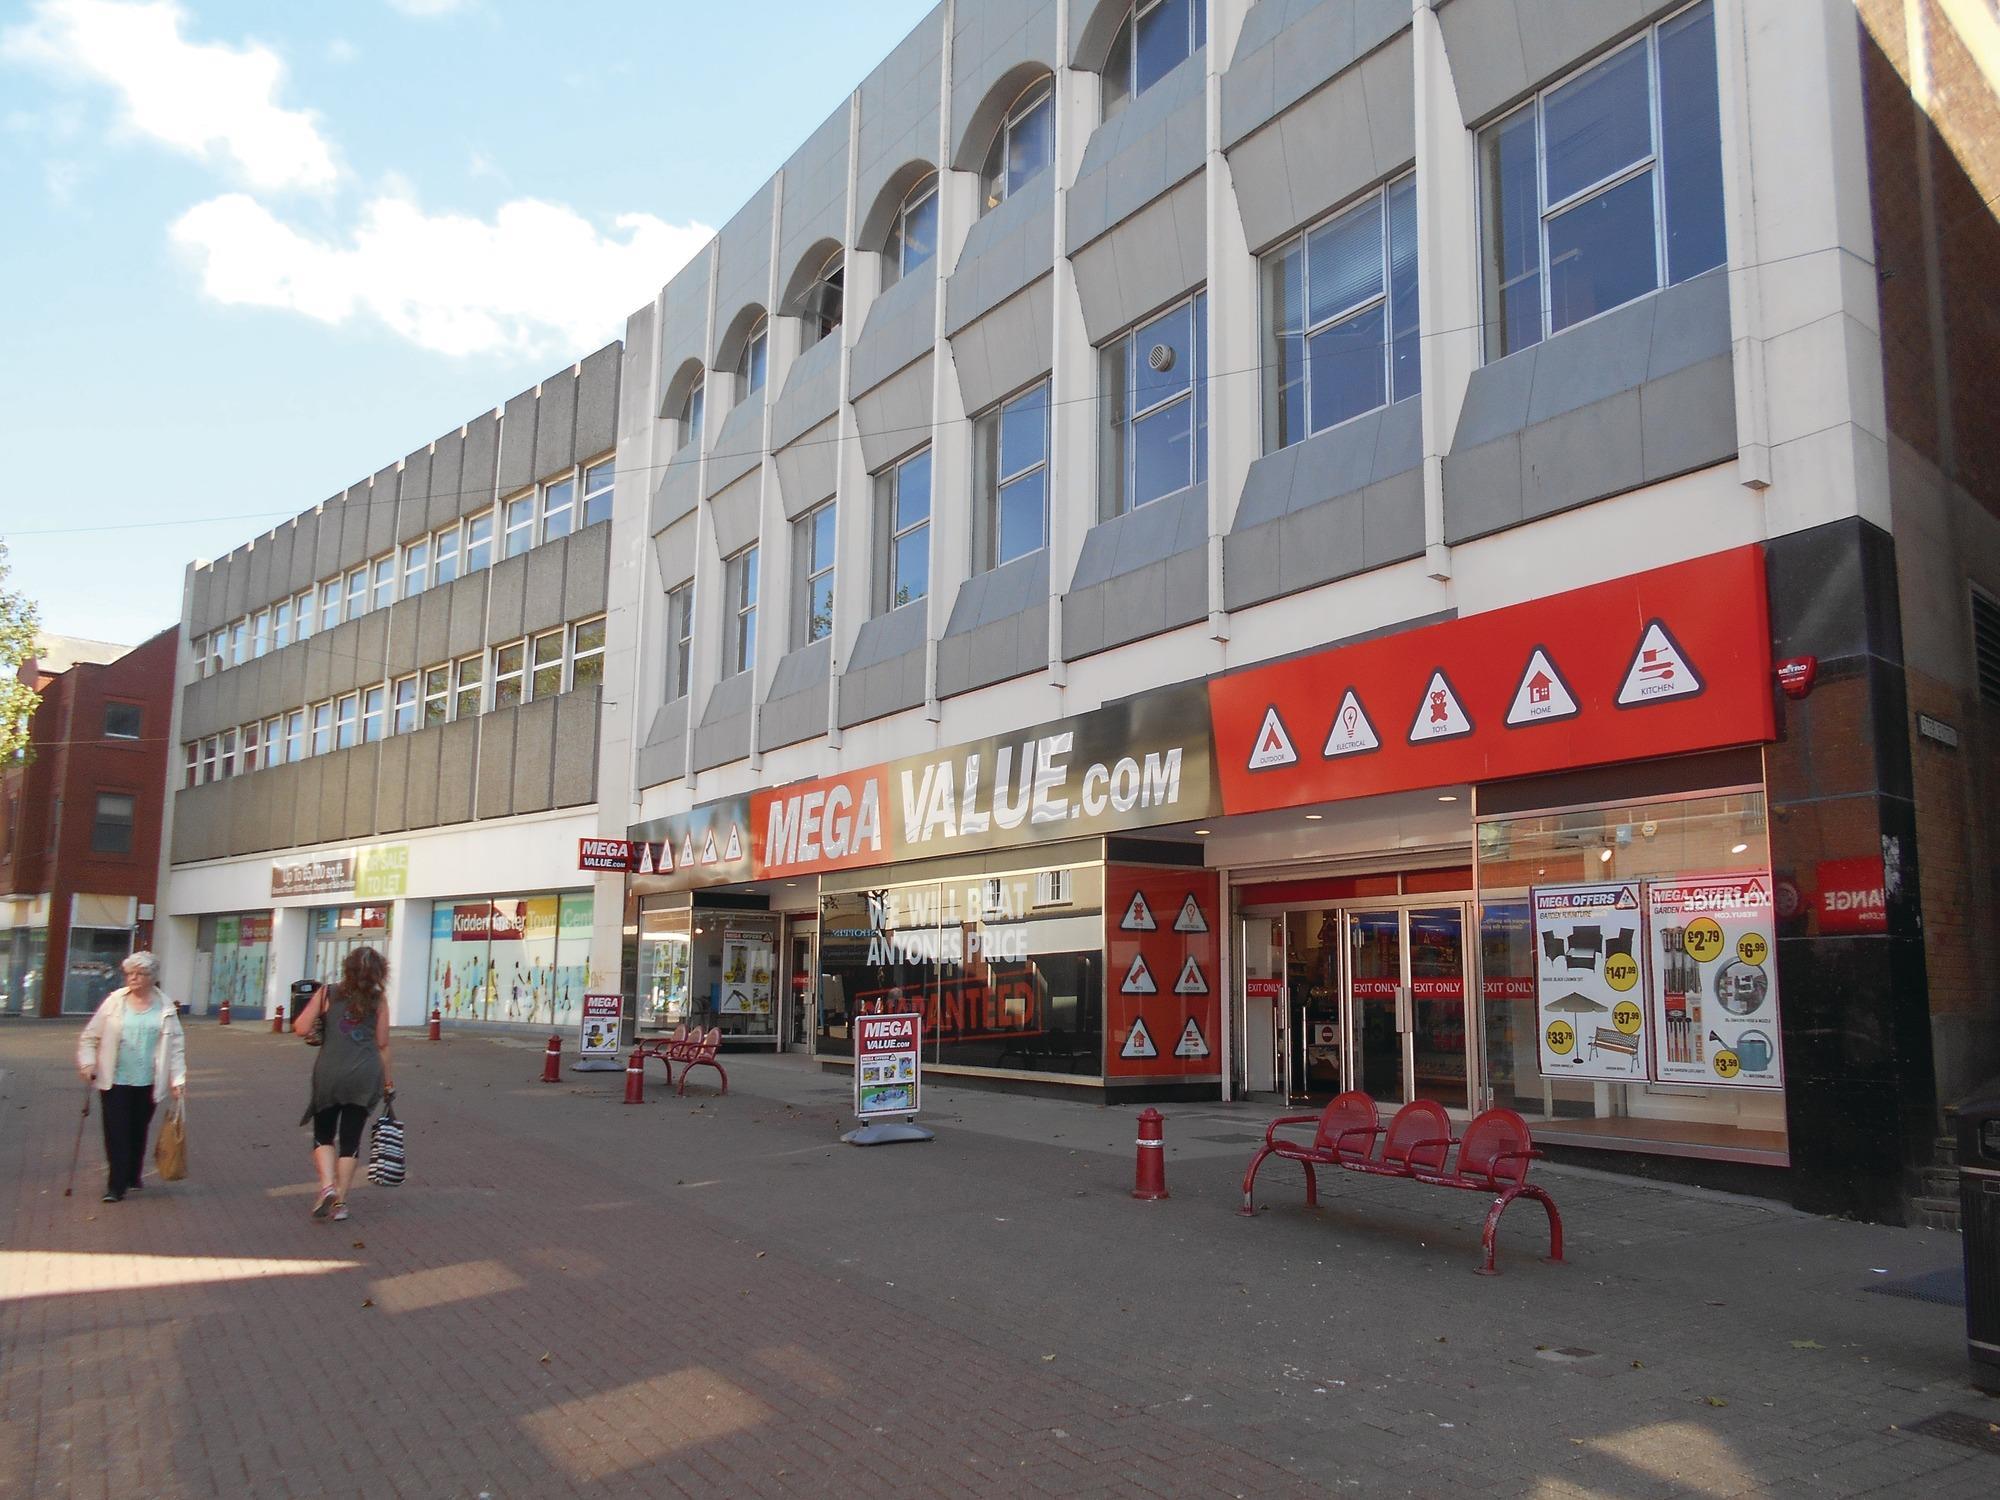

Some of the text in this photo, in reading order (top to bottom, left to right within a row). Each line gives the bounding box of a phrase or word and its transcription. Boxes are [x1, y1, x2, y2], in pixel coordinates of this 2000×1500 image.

[1640, 683, 1675, 696] KITCHEN
[1531, 706, 1552, 716] HOME
[1432, 725, 1448, 734] TOYS
[1336, 740, 1365, 750] ELECTRICAL
[1260, 754, 1285, 764] OUTDOOR
[764, 731, 1183, 867] MEGA VALUE.COM
[582, 841, 629, 857] MEGA
[1540, 893, 1615, 908] MEGA OFFERS
[1655, 888, 1689, 902] MEGA
[908, 888, 960, 928] WILL
[867, 927, 1028, 967] ANYONES PRICE
[1687, 930, 1720, 951] £2.79
[1739, 942, 1765, 958] £6.99
[1248, 983, 1282, 993] EXIT ONLY
[1354, 983, 1398, 993] EXIT ONLY
[1414, 982, 1461, 993] EXIT ONLY
[1482, 982, 1534, 993] EXIT ONLY
[588, 997, 619, 1008] MEGA
[864, 1020, 913, 1038] MEGA
